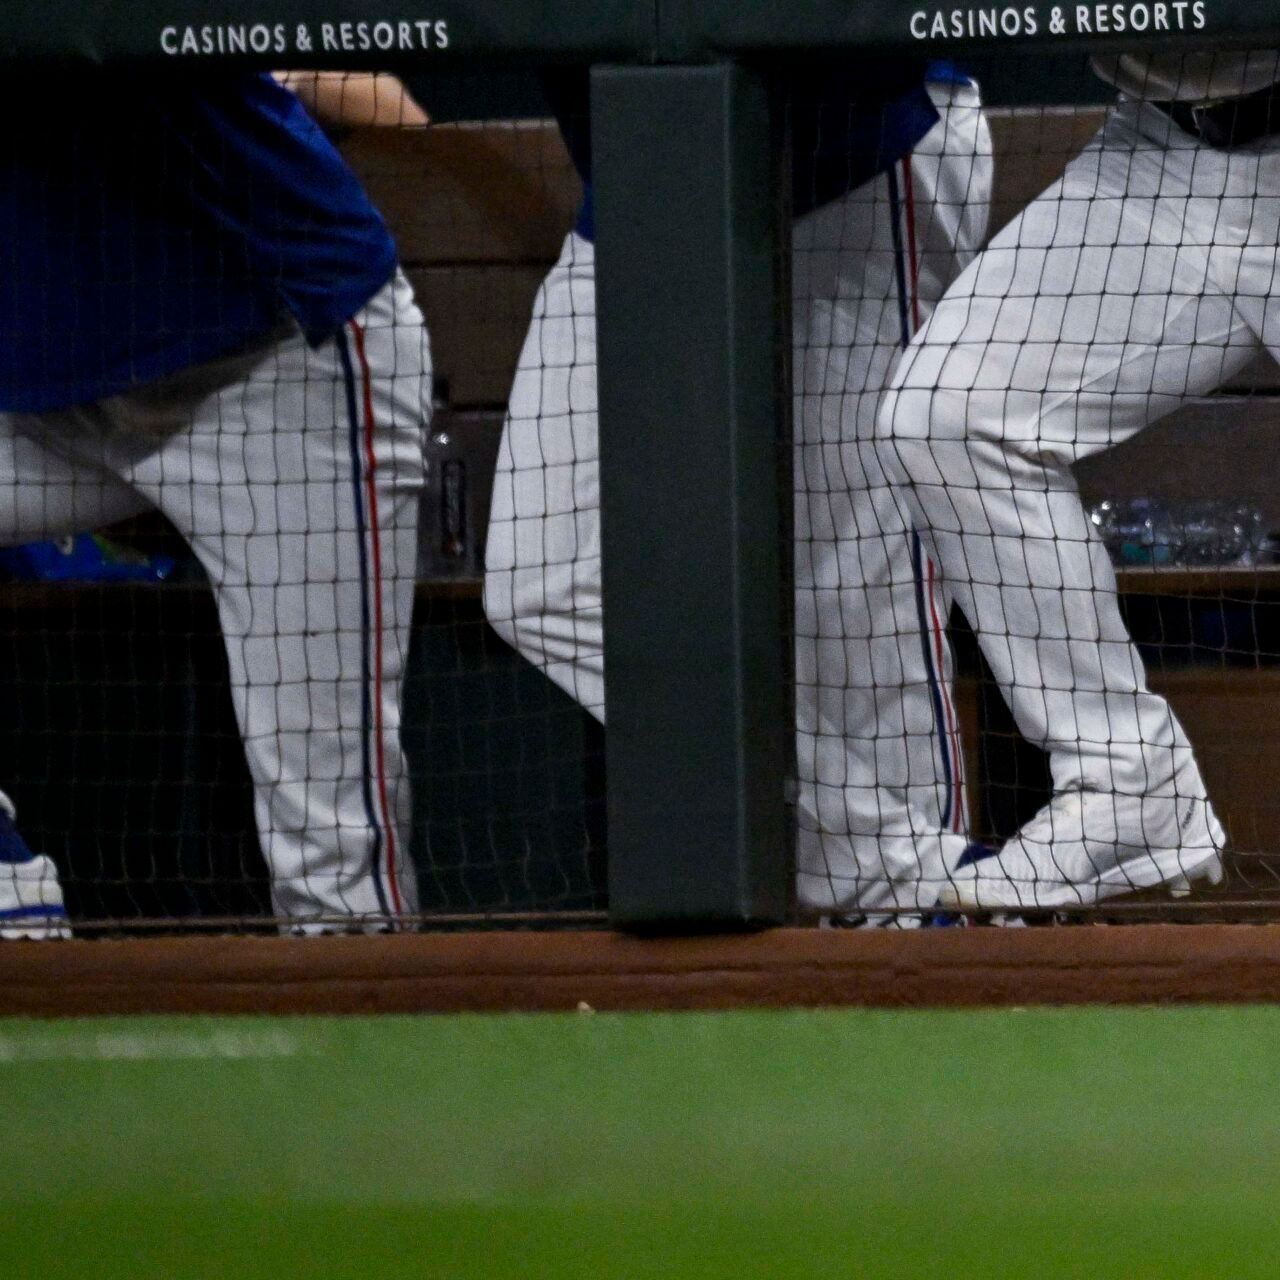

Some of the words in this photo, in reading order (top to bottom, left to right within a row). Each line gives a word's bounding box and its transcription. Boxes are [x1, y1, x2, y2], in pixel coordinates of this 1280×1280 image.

[160, 23, 287, 55] CASINOS
[295, 23, 313, 52] &
[321, 19, 450, 51] RESORTS
[909, 6, 1038, 39] CASINOS
[1047, 6, 1066, 35] &
[1075, 0, 1207, 33] RESORTS
